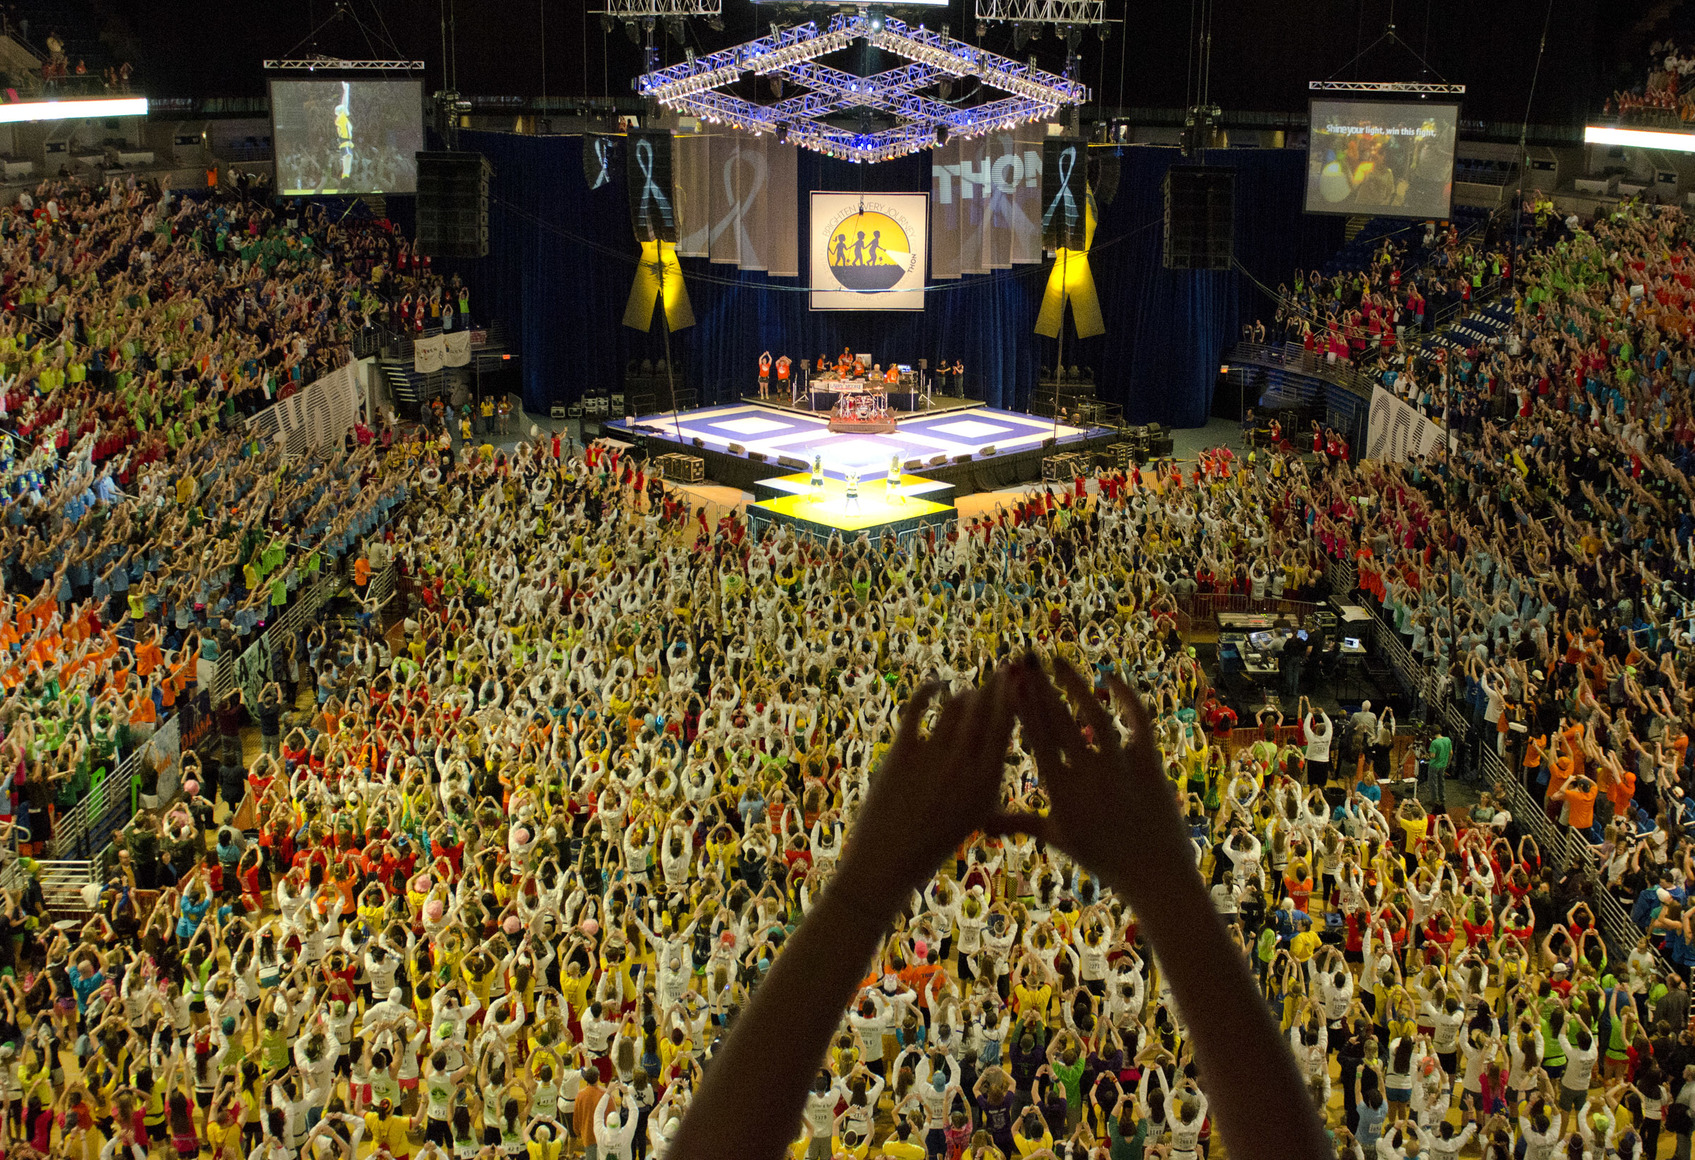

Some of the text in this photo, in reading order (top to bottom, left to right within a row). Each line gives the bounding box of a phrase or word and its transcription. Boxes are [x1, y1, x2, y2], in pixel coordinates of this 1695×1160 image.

[1347, 125, 1364, 136] your
[1365, 126, 1385, 136] light,
[1386, 127, 1400, 136] win
[1401, 127, 1415, 136] this
[1416, 127, 1437, 138] fight,
[822, 204, 857, 238] BRIGHTEN
[885, 206, 917, 238] JOURNEY
[906, 252, 918, 274] THON
